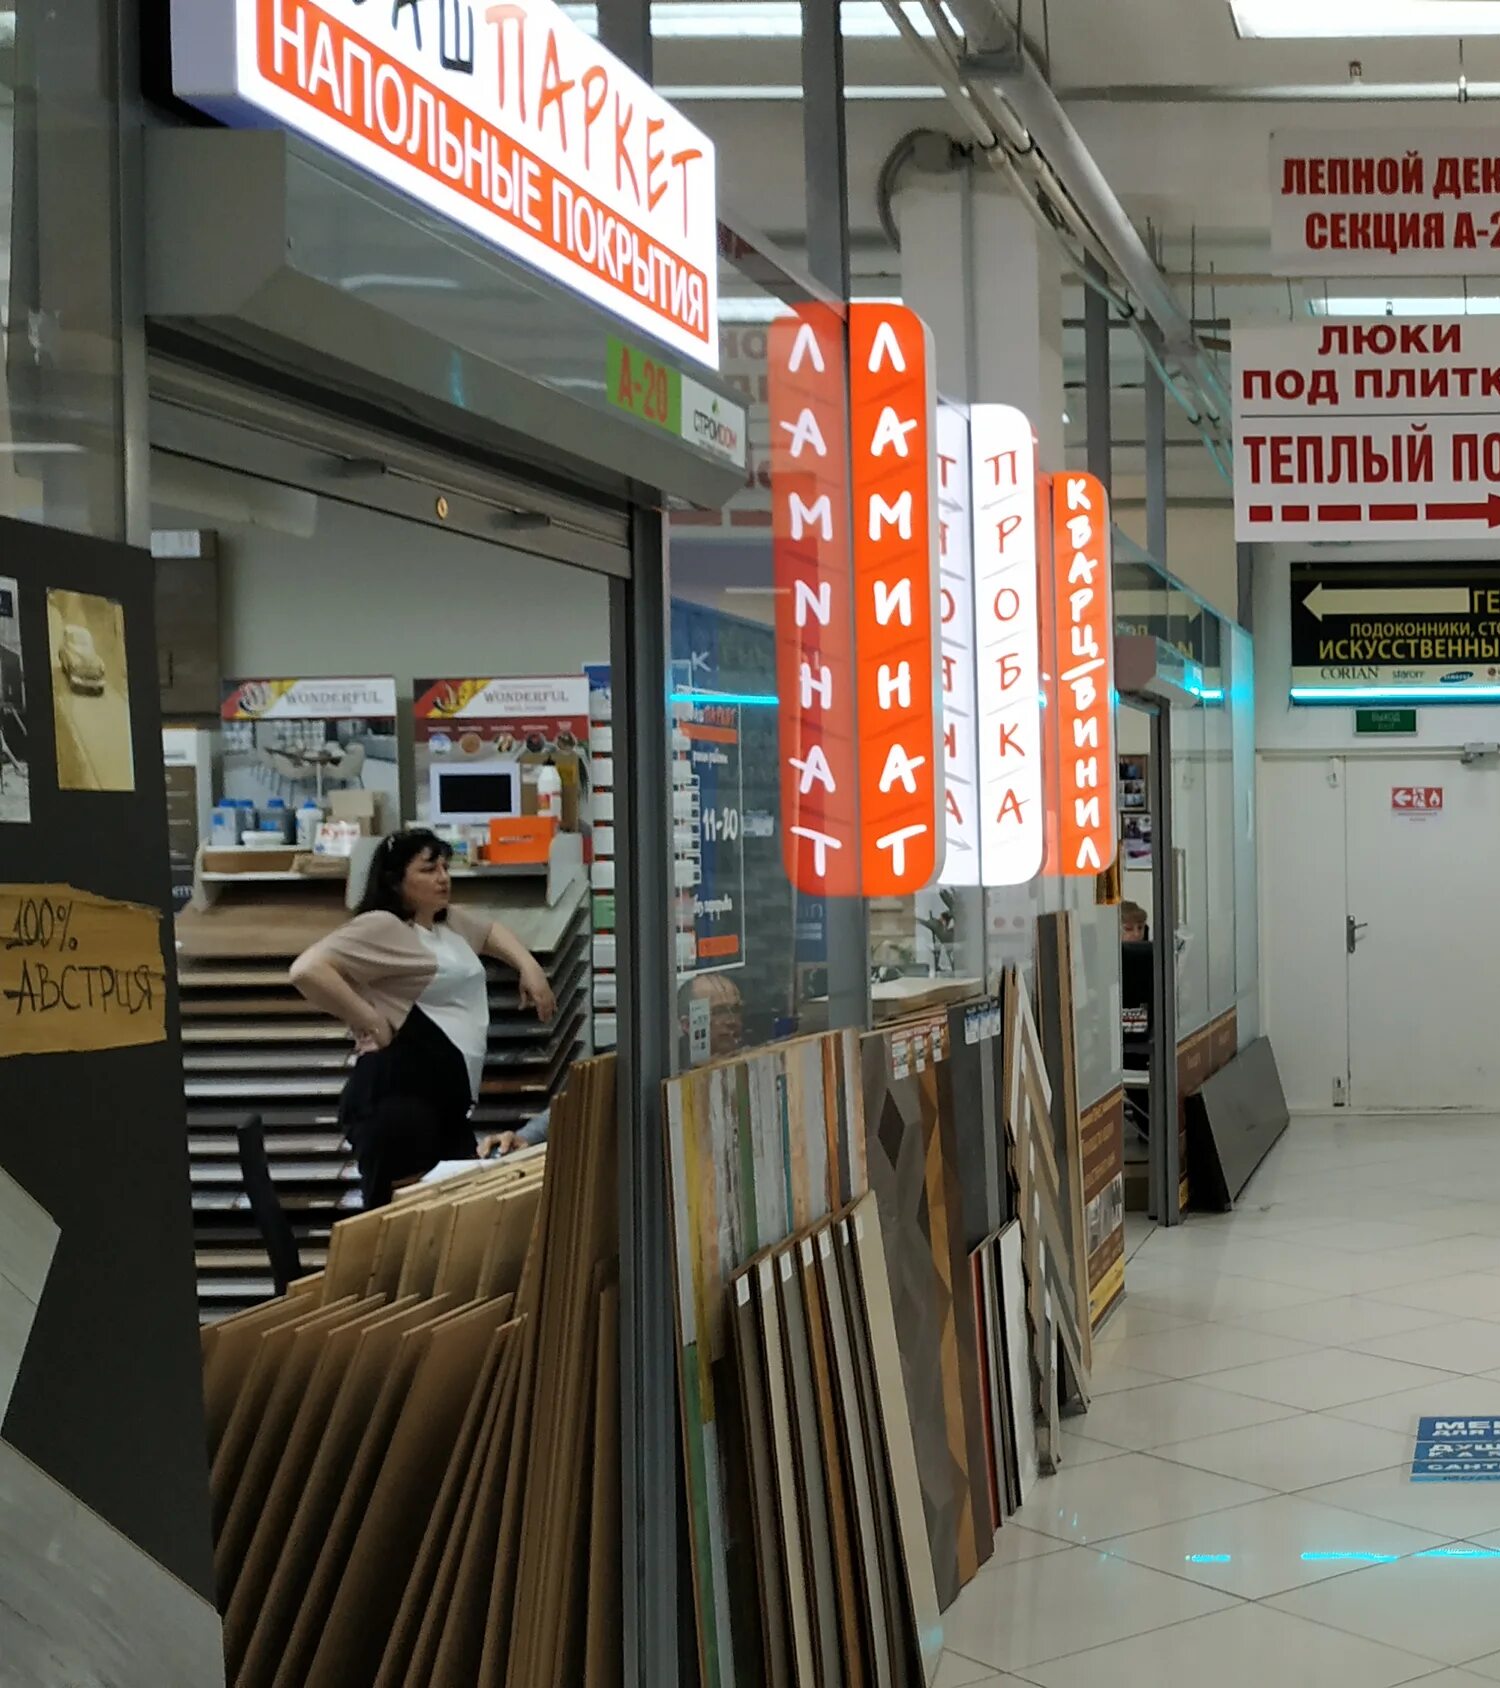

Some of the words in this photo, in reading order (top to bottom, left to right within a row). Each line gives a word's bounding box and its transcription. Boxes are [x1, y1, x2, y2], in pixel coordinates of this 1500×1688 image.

[486, 5, 703, 238] ПАРКЕТ
[274, 0, 543, 232] НАПОЛЬНЫЕ
[552, 178, 705, 333] ПОКРЫТИЯ
[1281, 151, 1424, 197] ЛЕПНОЙ
[1305, 212, 1443, 255] СЕКЦИЯ
[1318, 323, 1462, 356] ЛЮКИ
[1242, 368, 1339, 405] ПОД
[1243, 423, 1434, 484] ТЕПЛЫЙ
[867, 323, 928, 876] ЛАМИНАТ
[984, 450, 1028, 825] ПРОБКА
[1350, 622, 1475, 640] ПОДОКОННИКИ,
[1320, 666, 1379, 680] CORIAN
[286, 689, 382, 705] WONDERFUL
[484, 689, 569, 704] WONDERFUL
